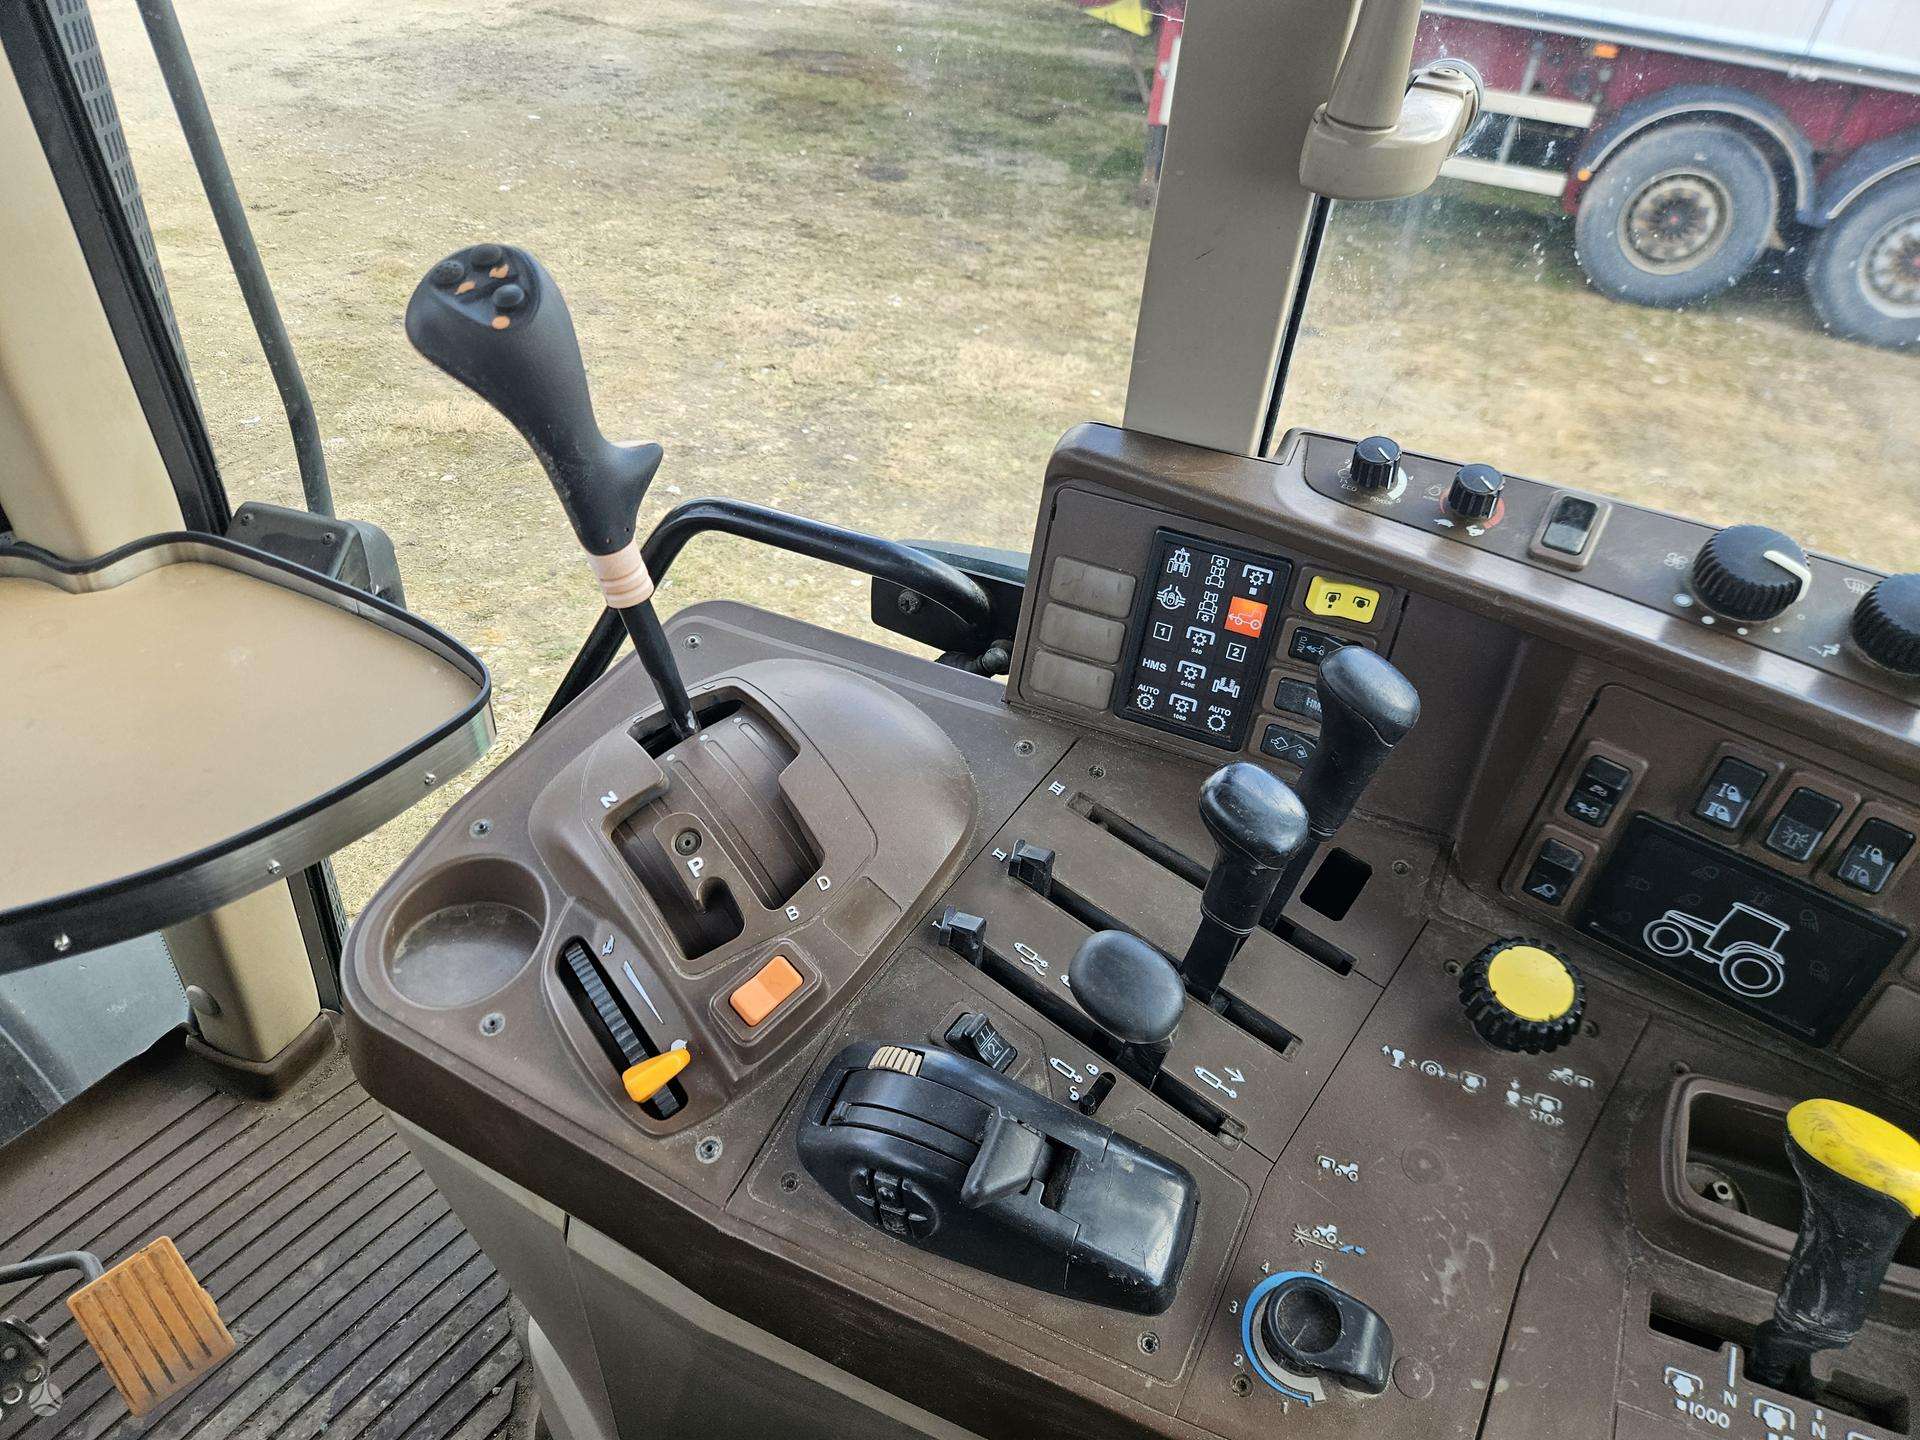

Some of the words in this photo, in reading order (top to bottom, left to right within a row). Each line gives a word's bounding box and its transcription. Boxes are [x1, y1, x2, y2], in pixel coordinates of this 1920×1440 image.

[1160, 627, 1166, 637] 1
[1191, 647, 1203, 655] 540
[1231, 647, 1240, 658] 2
[1296, 636, 1308, 653] AUTO
[1142, 658, 1167, 673] HMS
[1137, 683, 1160, 696] AUTO
[1208, 705, 1232, 717] AUTO
[1306, 697, 1322, 713] HM
[600, 790, 619, 809] N
[686, 857, 705, 878] P
[816, 875, 832, 891] D
[785, 905, 801, 922] B
[987, 1043, 1000, 1057] 2
[1528, 1108, 1565, 1127] STOP
[1229, 1300, 1239, 1314] 3
[1723, 1390, 1738, 1409] N
[1689, 1400, 1730, 1429] 1000
[1811, 1421, 1826, 1440] N
